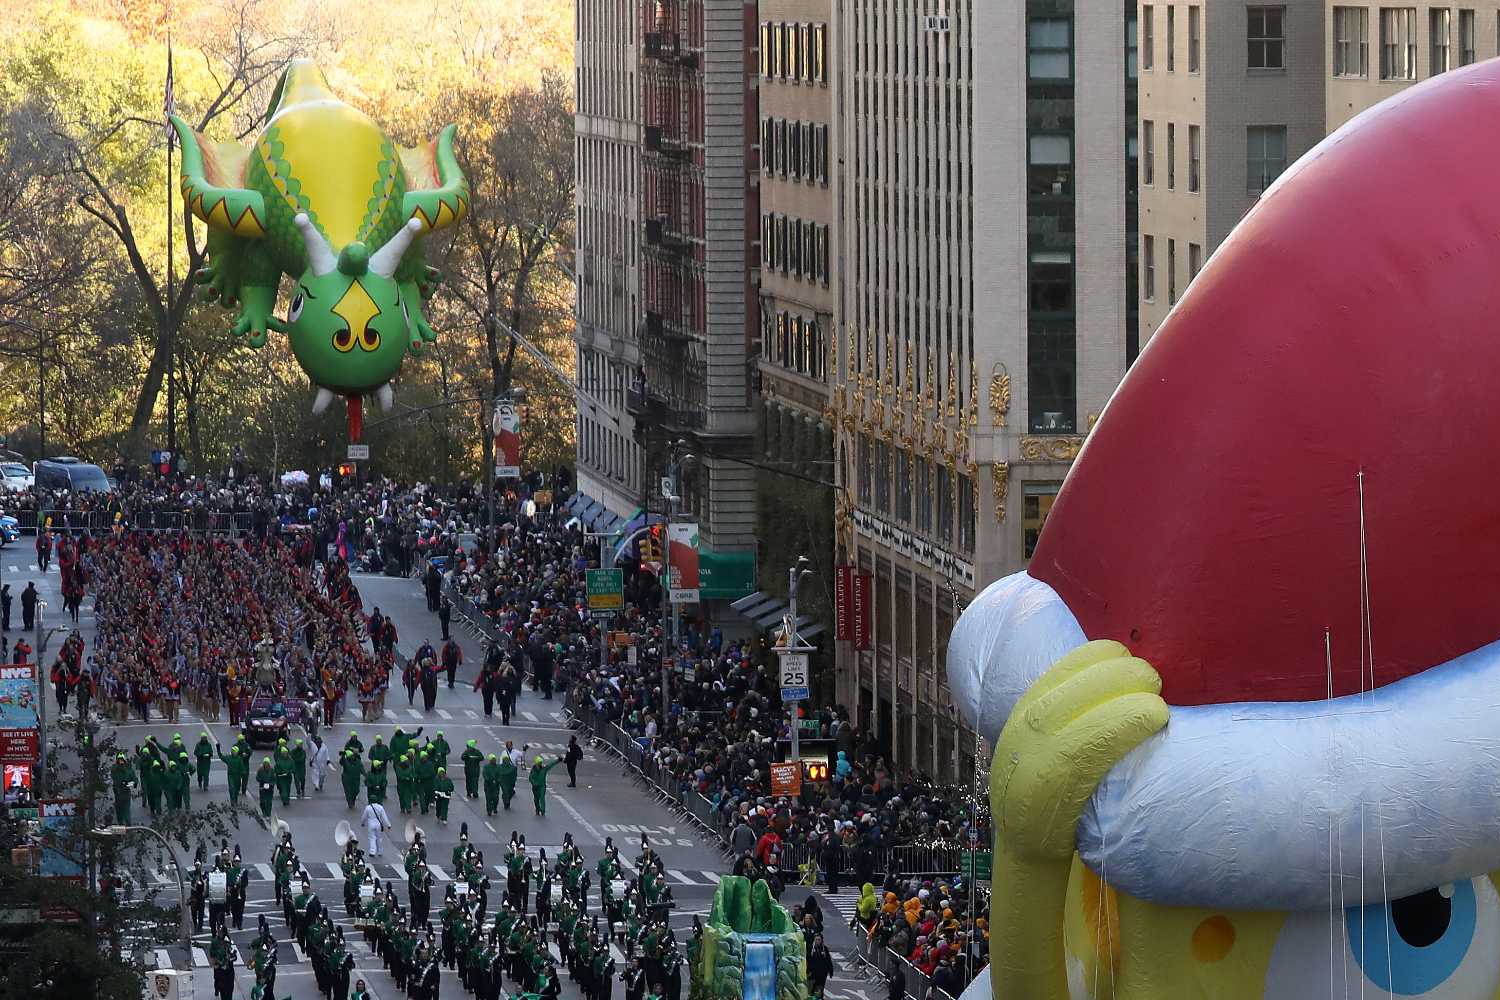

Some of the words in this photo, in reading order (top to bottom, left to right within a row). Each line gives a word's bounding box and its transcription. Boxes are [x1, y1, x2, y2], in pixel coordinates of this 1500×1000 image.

[1, 667, 33, 679] NYC
[783, 672, 805, 685] 25
[601, 824, 676, 835] ONLY
